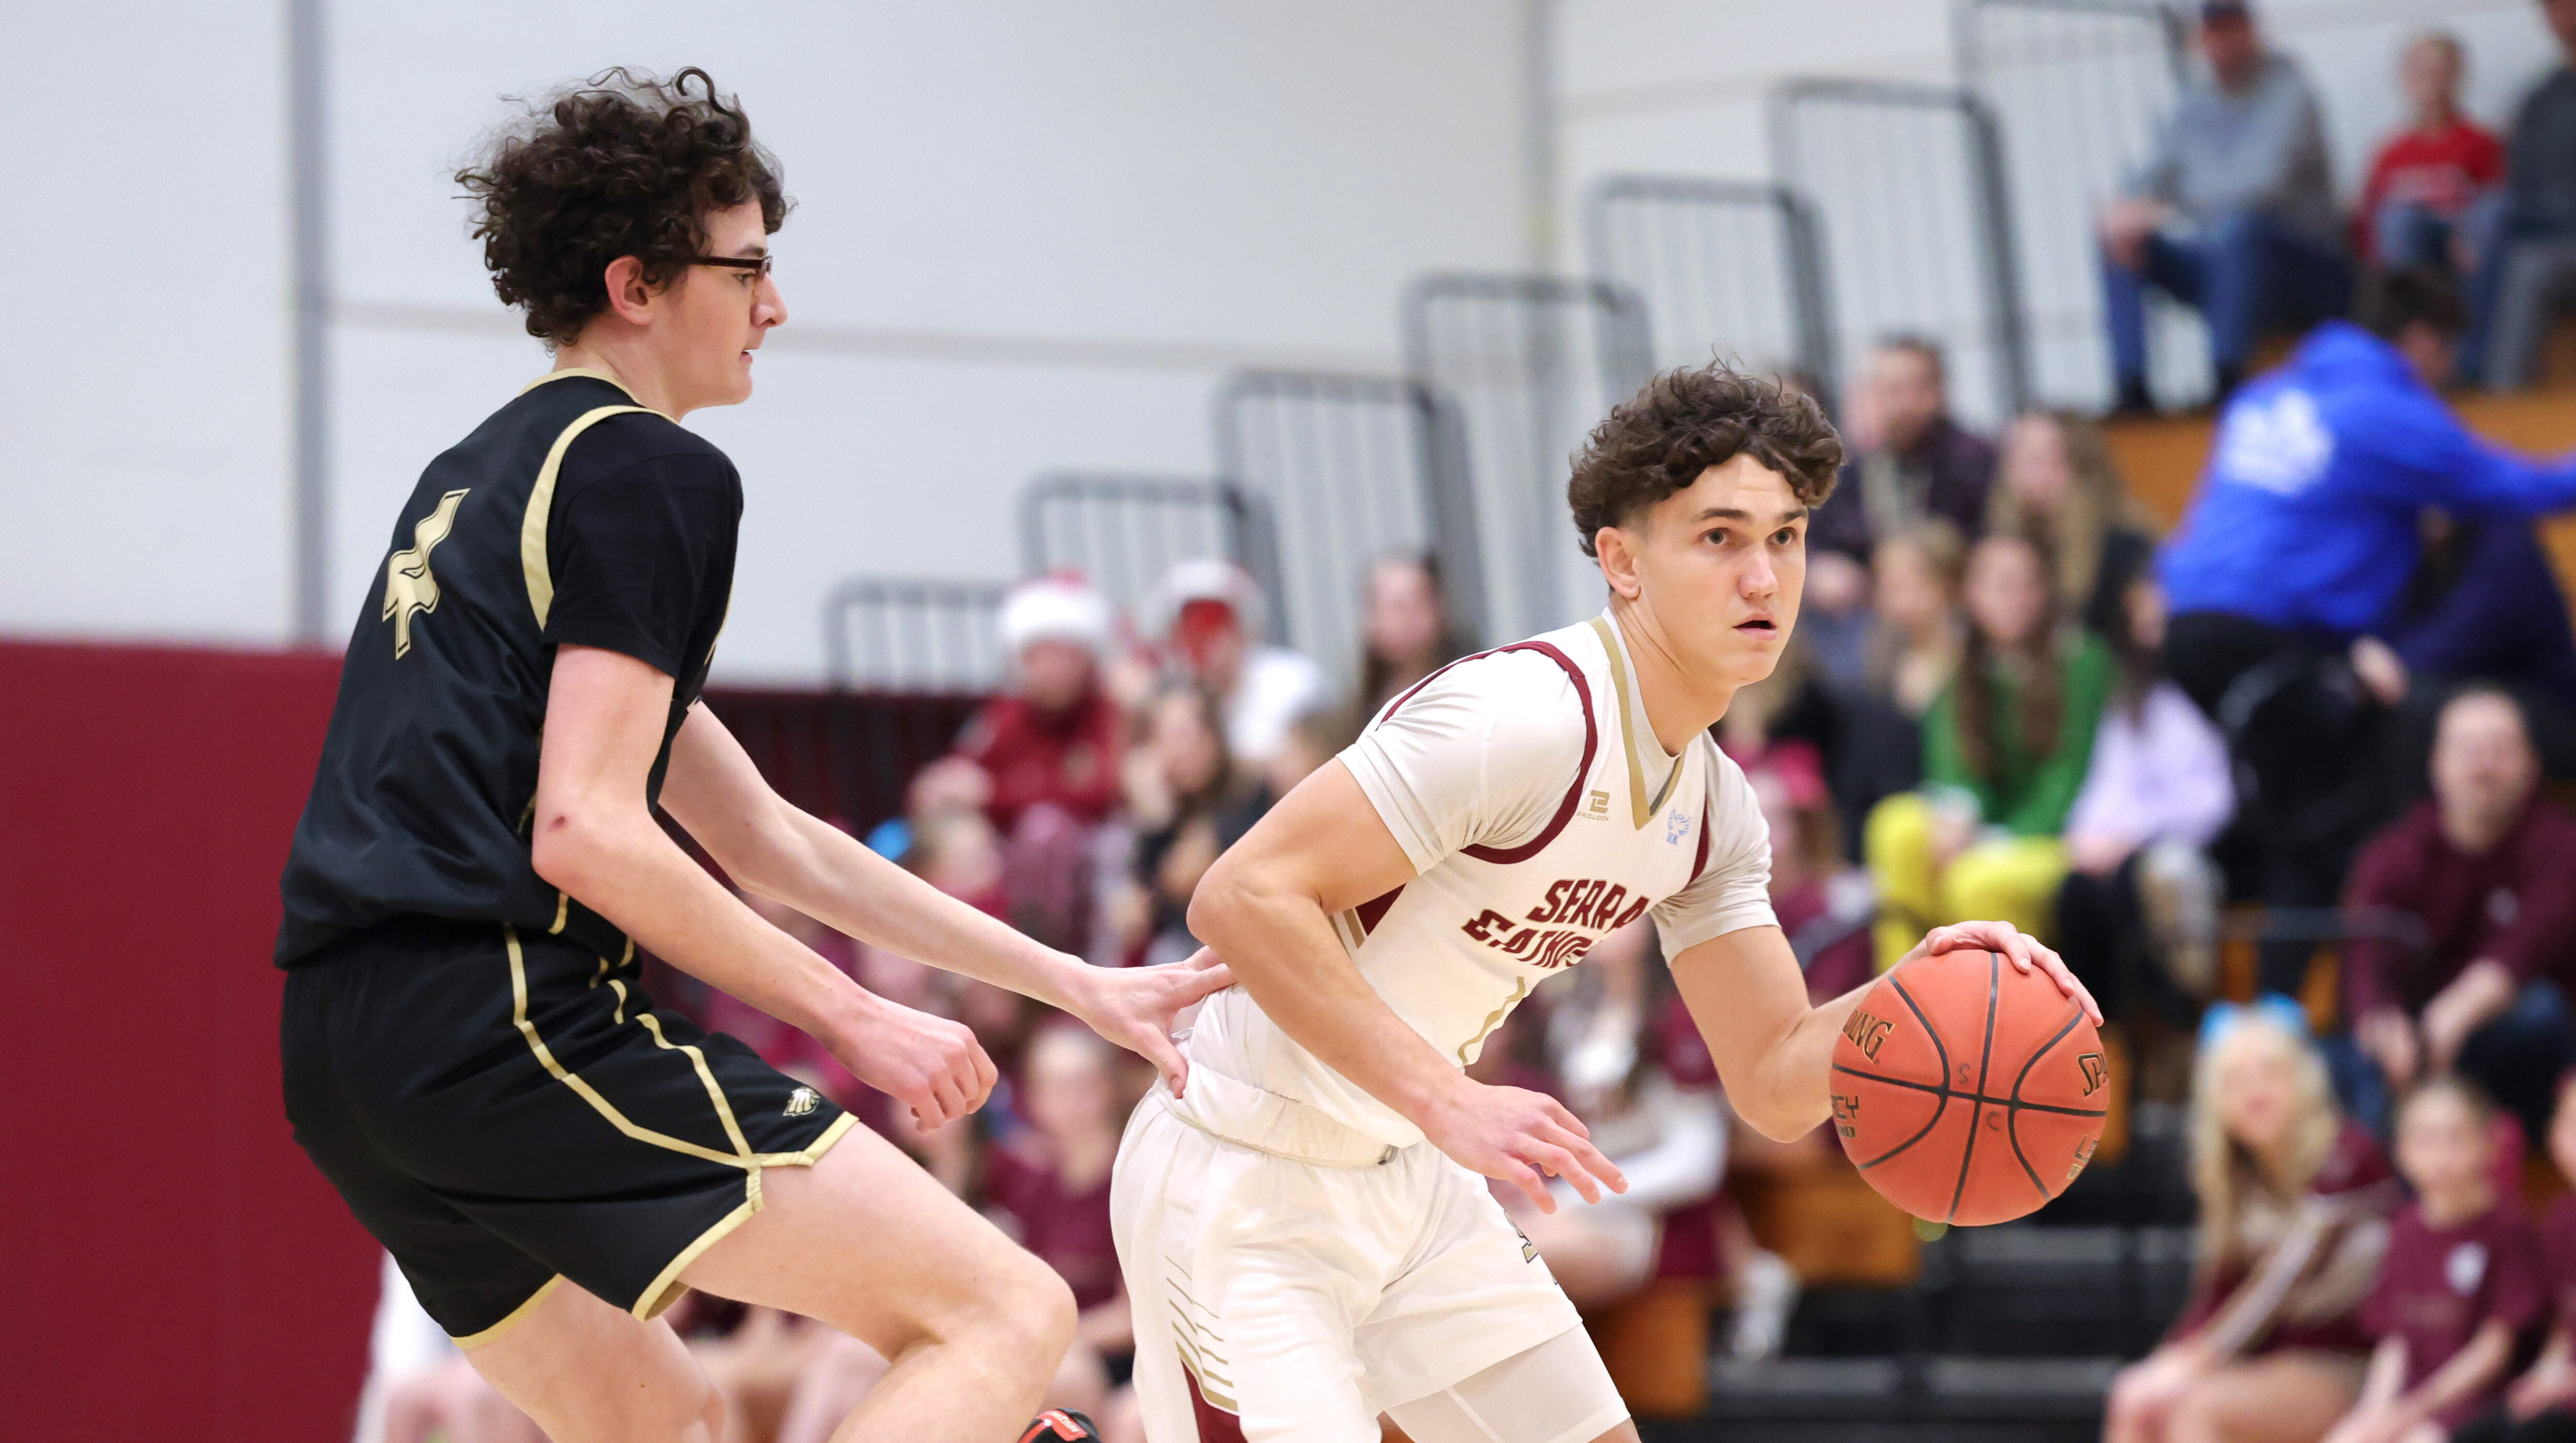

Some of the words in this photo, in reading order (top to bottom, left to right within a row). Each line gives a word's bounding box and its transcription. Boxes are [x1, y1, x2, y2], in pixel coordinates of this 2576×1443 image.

[382, 488, 471, 660] 4
[1577, 811, 1610, 822] PROLOOK
[1525, 879, 1651, 934] SERRA
